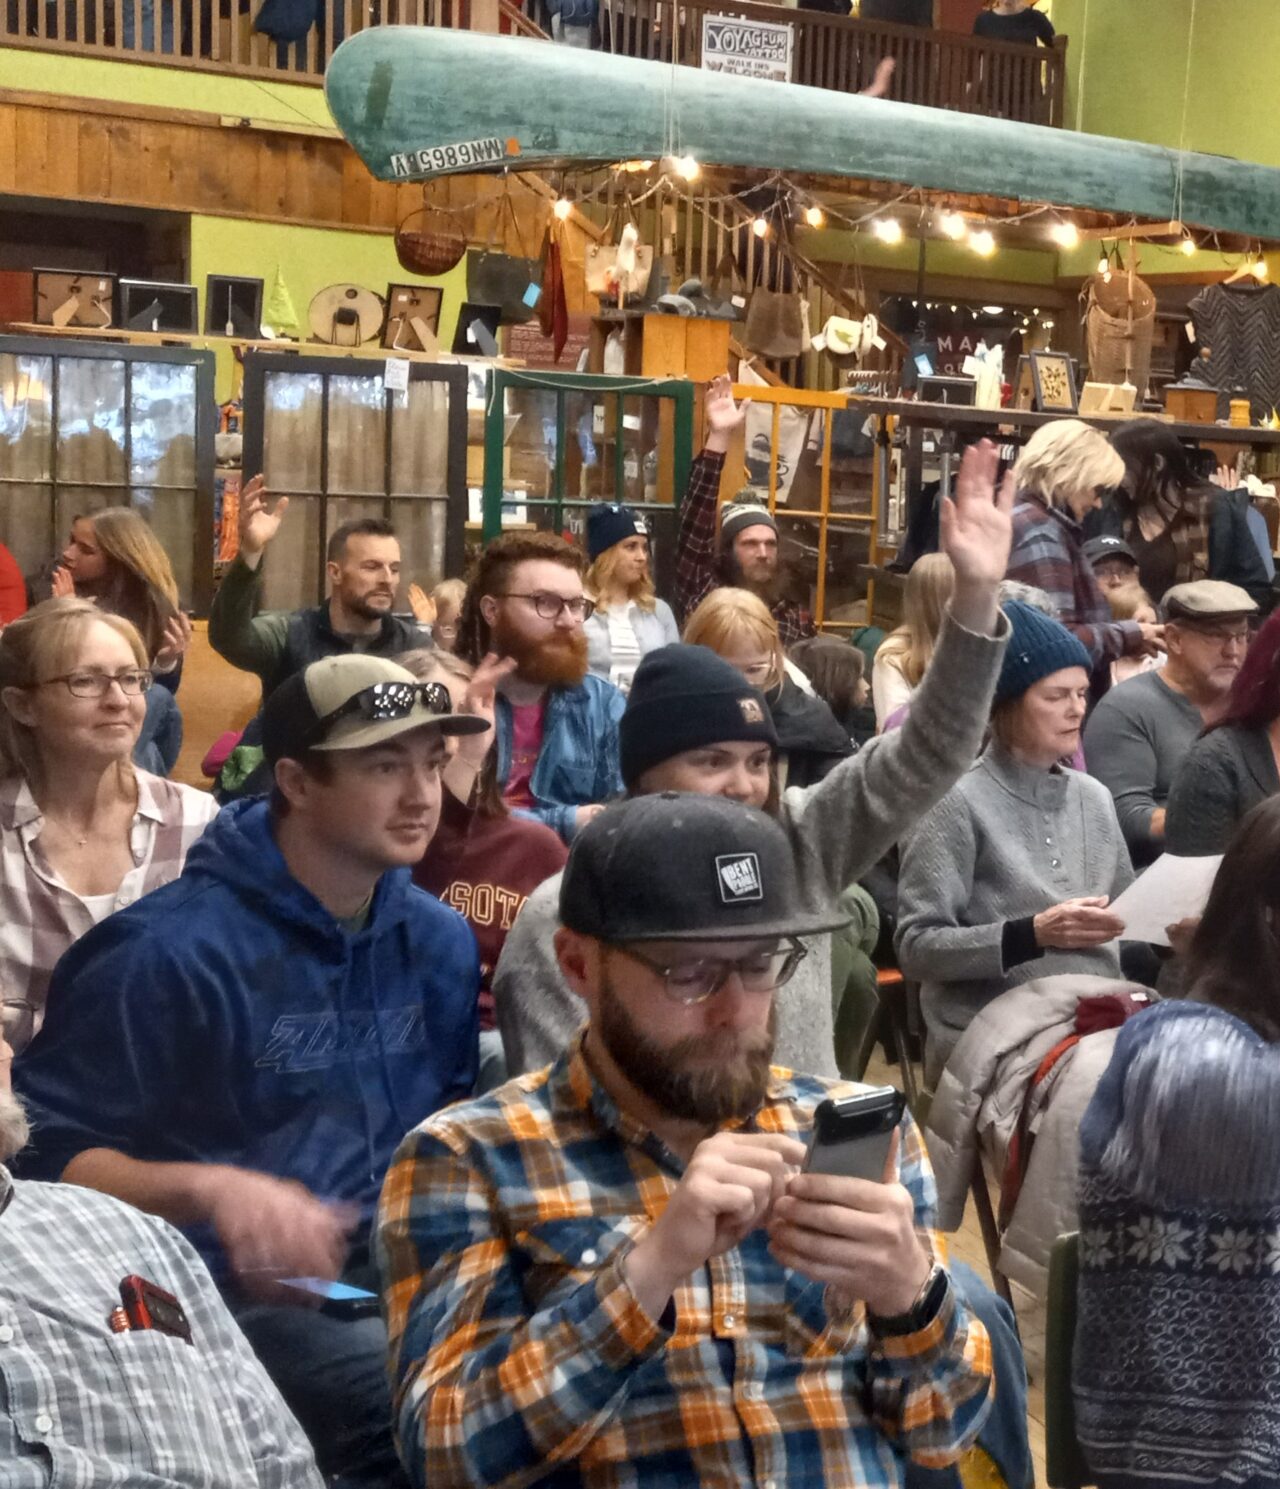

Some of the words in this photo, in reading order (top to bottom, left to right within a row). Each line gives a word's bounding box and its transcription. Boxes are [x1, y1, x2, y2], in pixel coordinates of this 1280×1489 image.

[707, 25, 787, 52] VOYAGEUR
[744, 47, 785, 60] TATTOO
[440, 881, 529, 929] SOT
